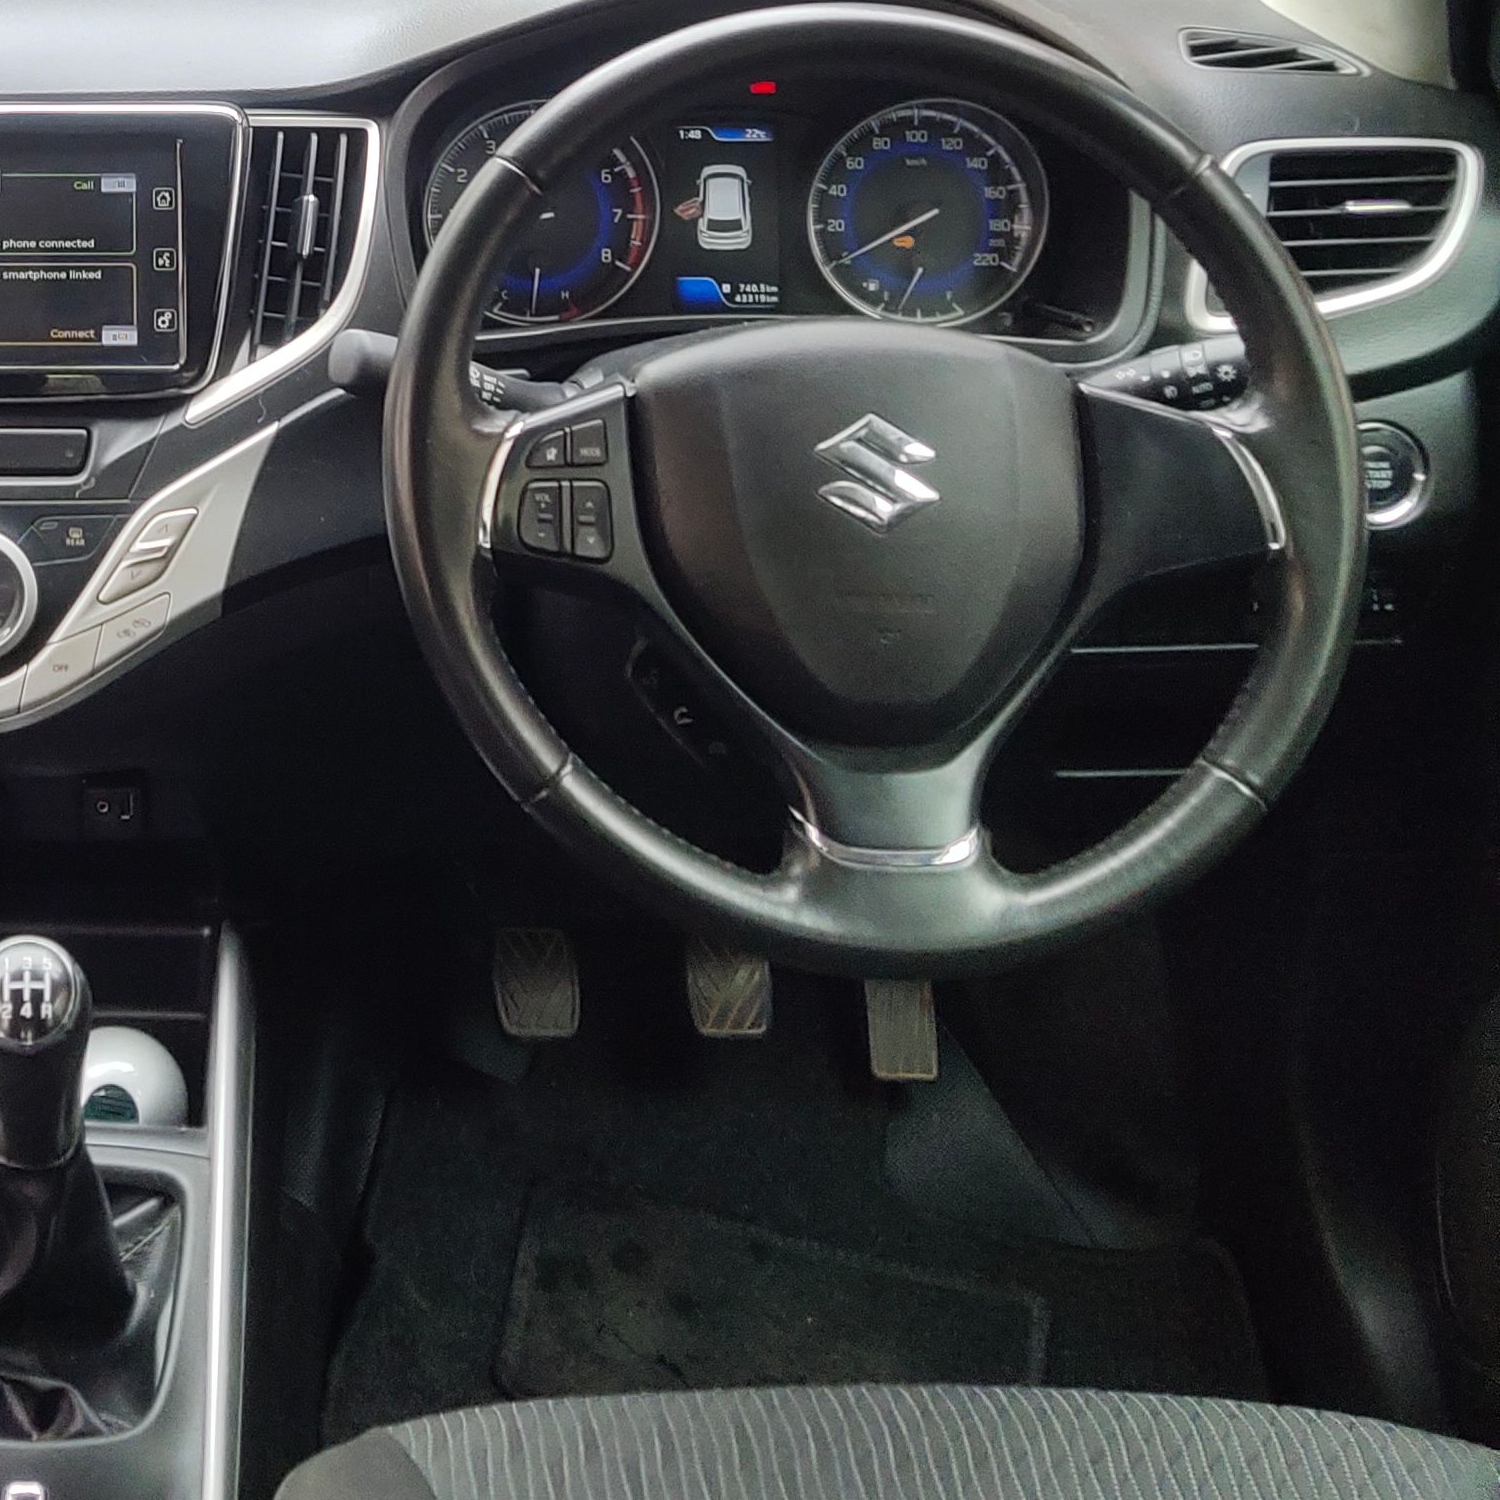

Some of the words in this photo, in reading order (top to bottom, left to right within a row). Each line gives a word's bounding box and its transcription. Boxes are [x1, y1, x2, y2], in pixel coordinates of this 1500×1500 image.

[905, 130, 928, 143] 100
[486, 140, 496, 155] 3
[872, 137, 891, 150] 80
[941, 137, 963, 150] 120
[846, 157, 864, 170] 60
[966, 157, 988, 170] 140
[456, 168, 468, 183] 2
[600, 169, 612, 184] 6
[73, 180, 94, 190] Call
[828, 184, 847, 197] 40
[985, 186, 1007, 199] 160
[612, 209, 622, 223] 7
[827, 219, 845, 232] 20
[988, 219, 1010, 232] 180
[2, 238, 37, 251] phone
[38, 238, 95, 248] connected
[601, 248, 612, 263] 8
[973, 253, 999, 265] 220
[2, 270, 68, 282] smartphone
[69, 270, 102, 280] linked
[501, 290, 508, 300] C
[561, 290, 569, 300] H
[50, 329, 95, 339] Connect
[66, 537, 85, 547] REAR
[52, 664, 69, 672] OFF
[22, 956, 32, 970] 3
[43, 957, 53, 970] 5
[1, 1002, 13, 1020] 2
[19, 1001, 33, 1019] 4
[41, 1002, 53, 1020] R
